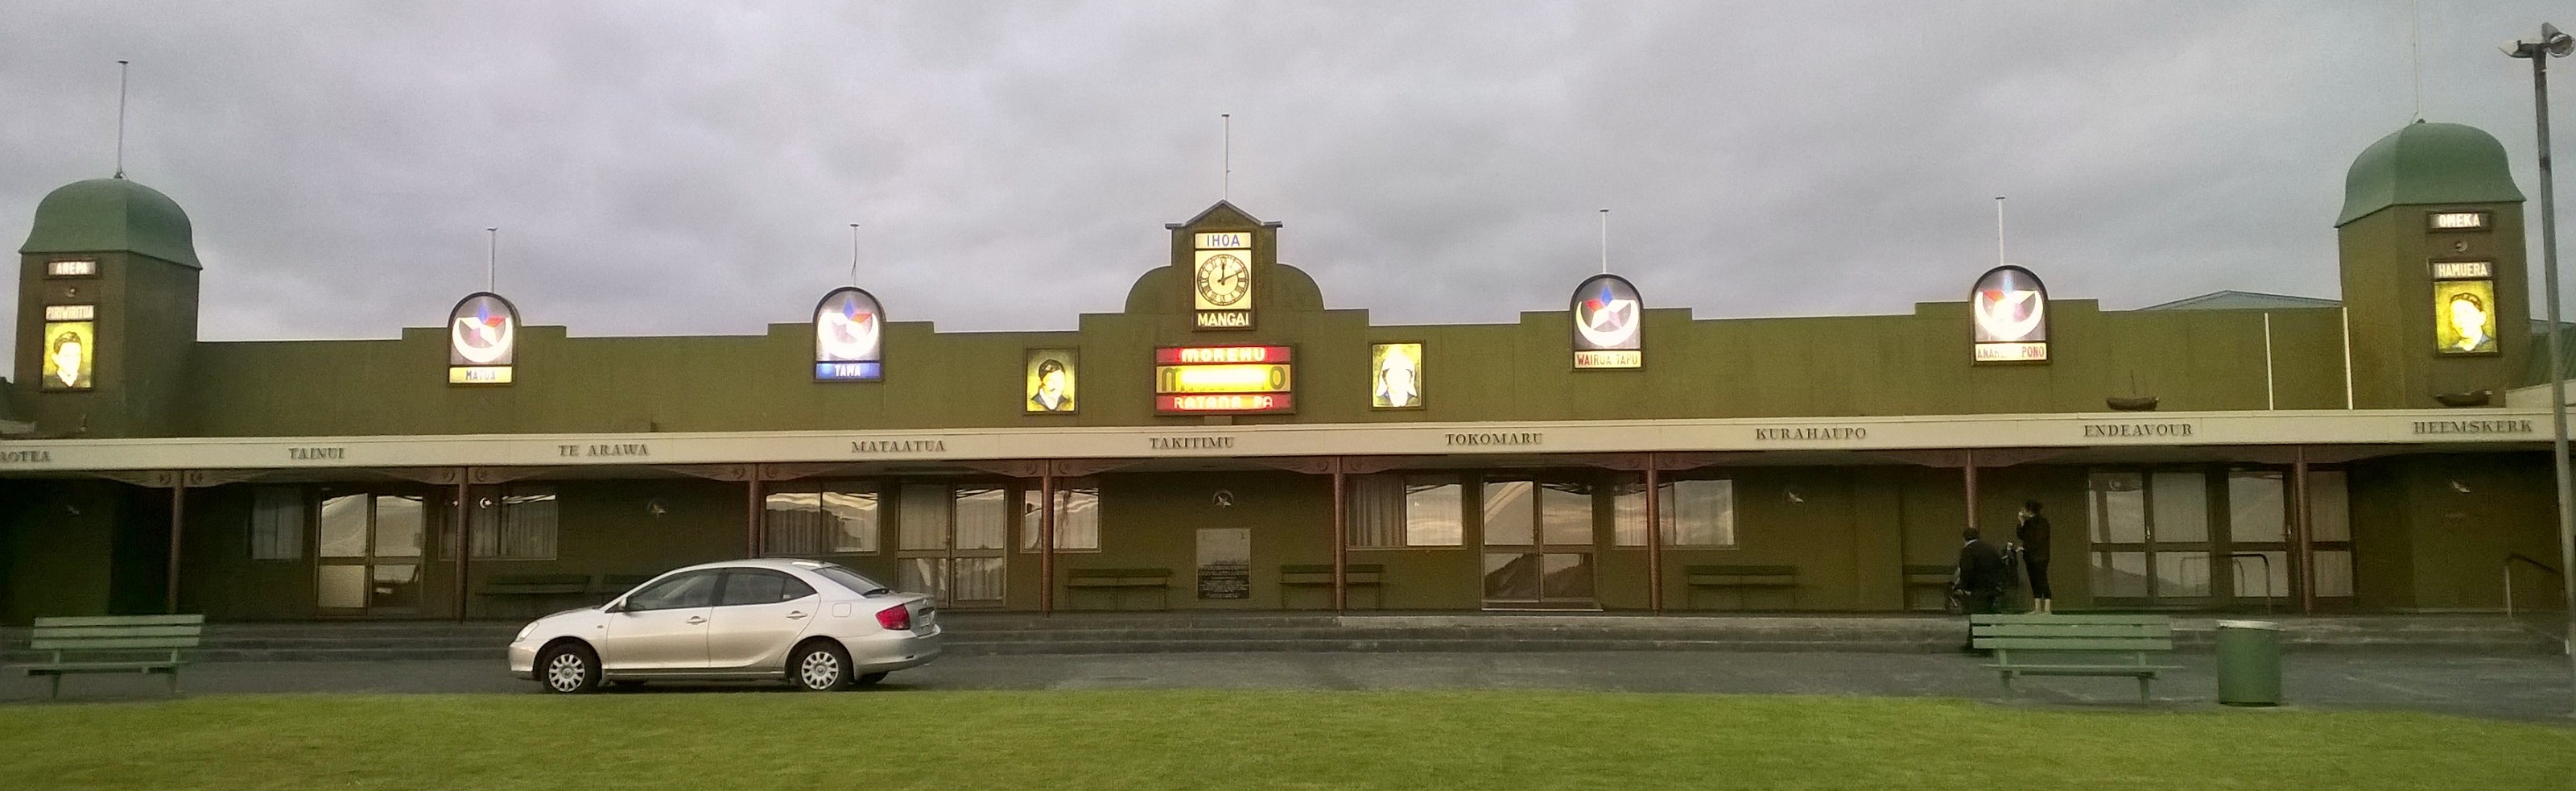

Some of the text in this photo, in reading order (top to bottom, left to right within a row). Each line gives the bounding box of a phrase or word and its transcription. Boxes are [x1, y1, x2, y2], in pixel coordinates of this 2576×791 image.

[2439, 213, 2480, 228] OMEKA
[1208, 234, 1240, 246] IHOA
[2438, 263, 2487, 277] HAMUERA
[1197, 313, 1249, 326] MANGAI
[2022, 346, 2045, 358] PONO
[1577, 354, 1637, 366] WAIRUA TAPU
[465, 370, 496, 381] MATUA
[2083, 424, 2193, 437] ENDEAVOUR
[2413, 420, 2533, 434] HEEMSKERK
[1445, 433, 1543, 445] TOKOMARU
[1756, 427, 1866, 441] KURAHAUPO
[852, 440, 946, 453] MATAATUA
[1150, 437, 1235, 449] TAKITIMU
[288, 447, 345, 459] TAINUI
[559, 444, 650, 457] TE ARAWA
